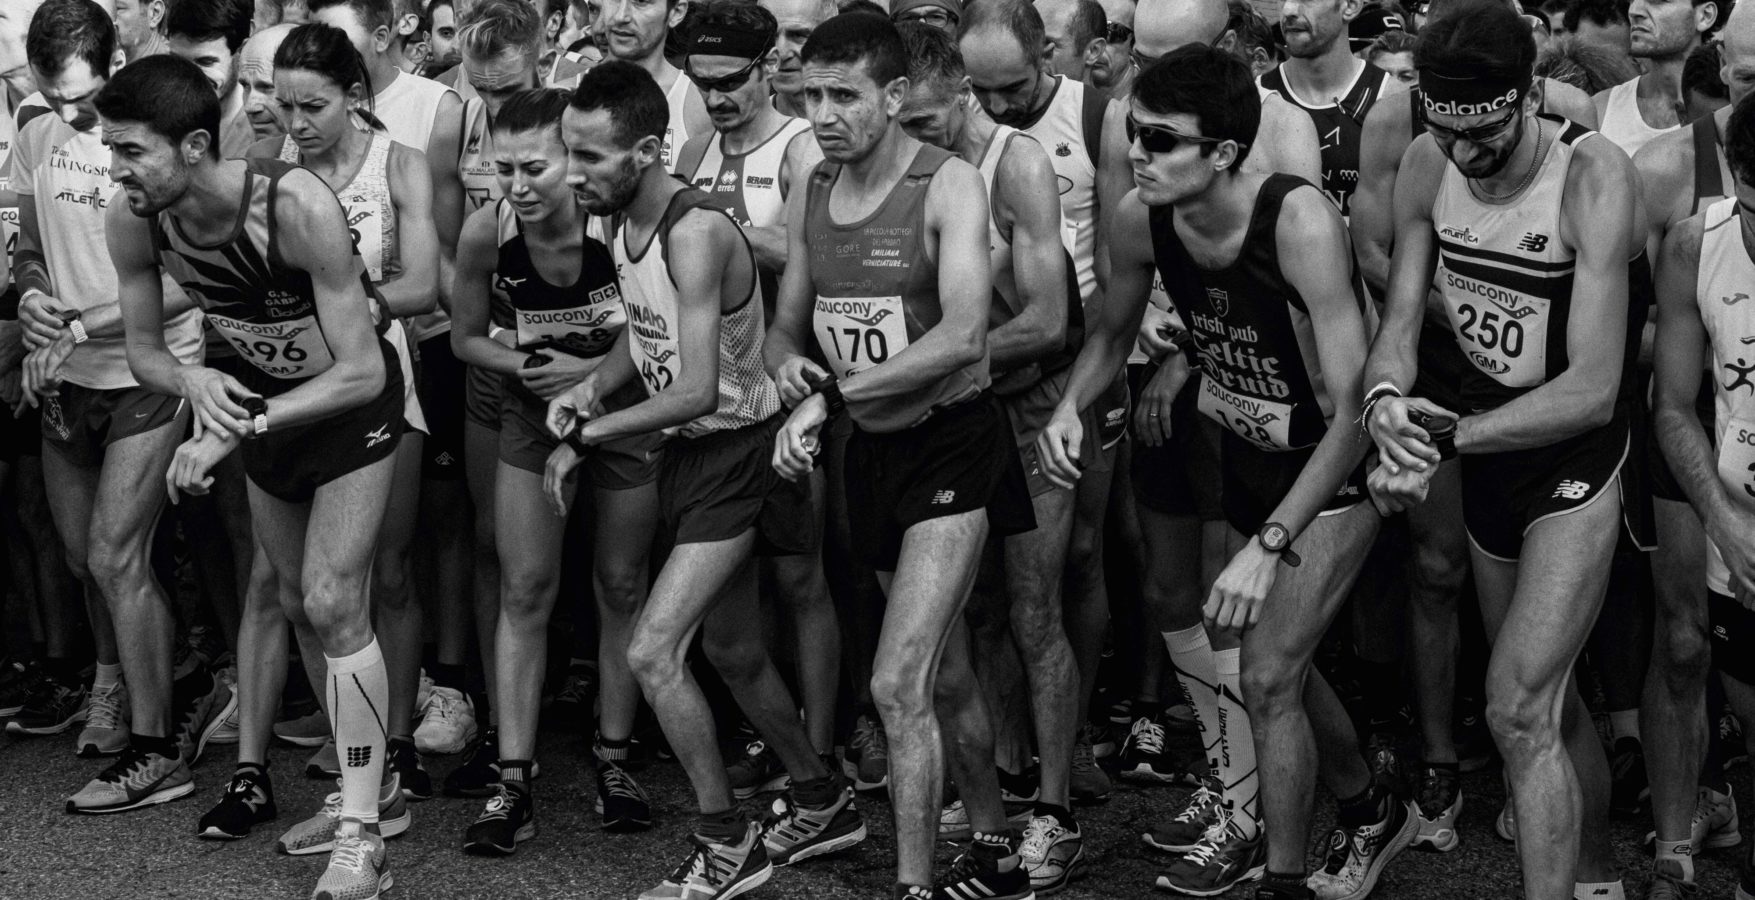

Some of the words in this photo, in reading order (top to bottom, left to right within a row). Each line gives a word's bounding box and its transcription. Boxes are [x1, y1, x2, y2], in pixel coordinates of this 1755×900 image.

[1425, 88, 1517, 115] balance
[50, 157, 92, 174] LIVING
[836, 244, 861, 254] GORE
[1447, 273, 1519, 309] saucony
[523, 307, 594, 325] saucony
[817, 301, 872, 318] saucony
[209, 316, 284, 336] saucony
[1190, 310, 1226, 336] irish
[1228, 325, 1259, 343] pub
[1457, 303, 1524, 358] 250
[231, 337, 308, 363] 396
[826, 328, 888, 364] 170
[1193, 329, 1280, 375] Celtic
[1206, 379, 1261, 416] saucony
